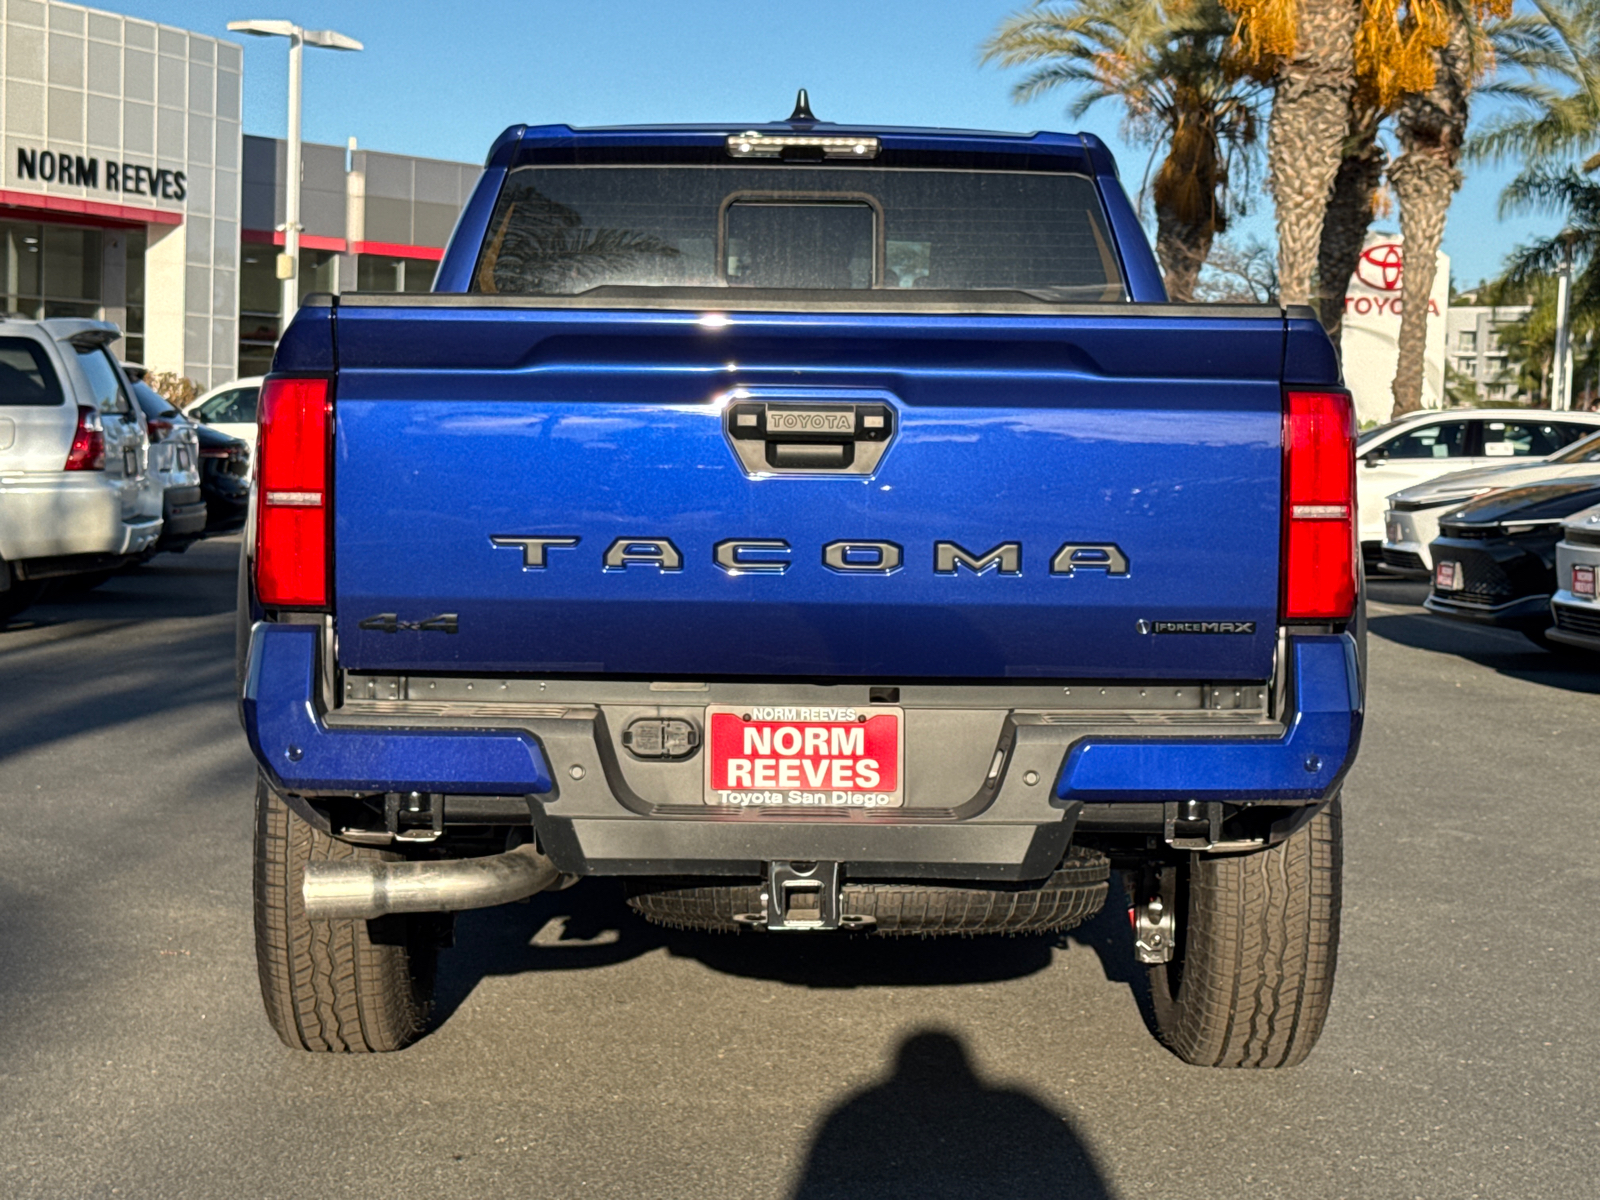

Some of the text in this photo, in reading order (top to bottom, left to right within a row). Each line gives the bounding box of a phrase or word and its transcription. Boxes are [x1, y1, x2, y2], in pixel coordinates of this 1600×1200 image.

[17, 147, 187, 201] NORM REEVES
[1344, 296, 1440, 316] TOYOA
[771, 414, 850, 430] TOYOTA
[490, 535, 1132, 579] TACOMA
[752, 708, 856, 721] NORM REEVES
[743, 727, 864, 755] NORM
[727, 759, 880, 788] REEVES
[718, 790, 890, 807] Toyota San Diego
